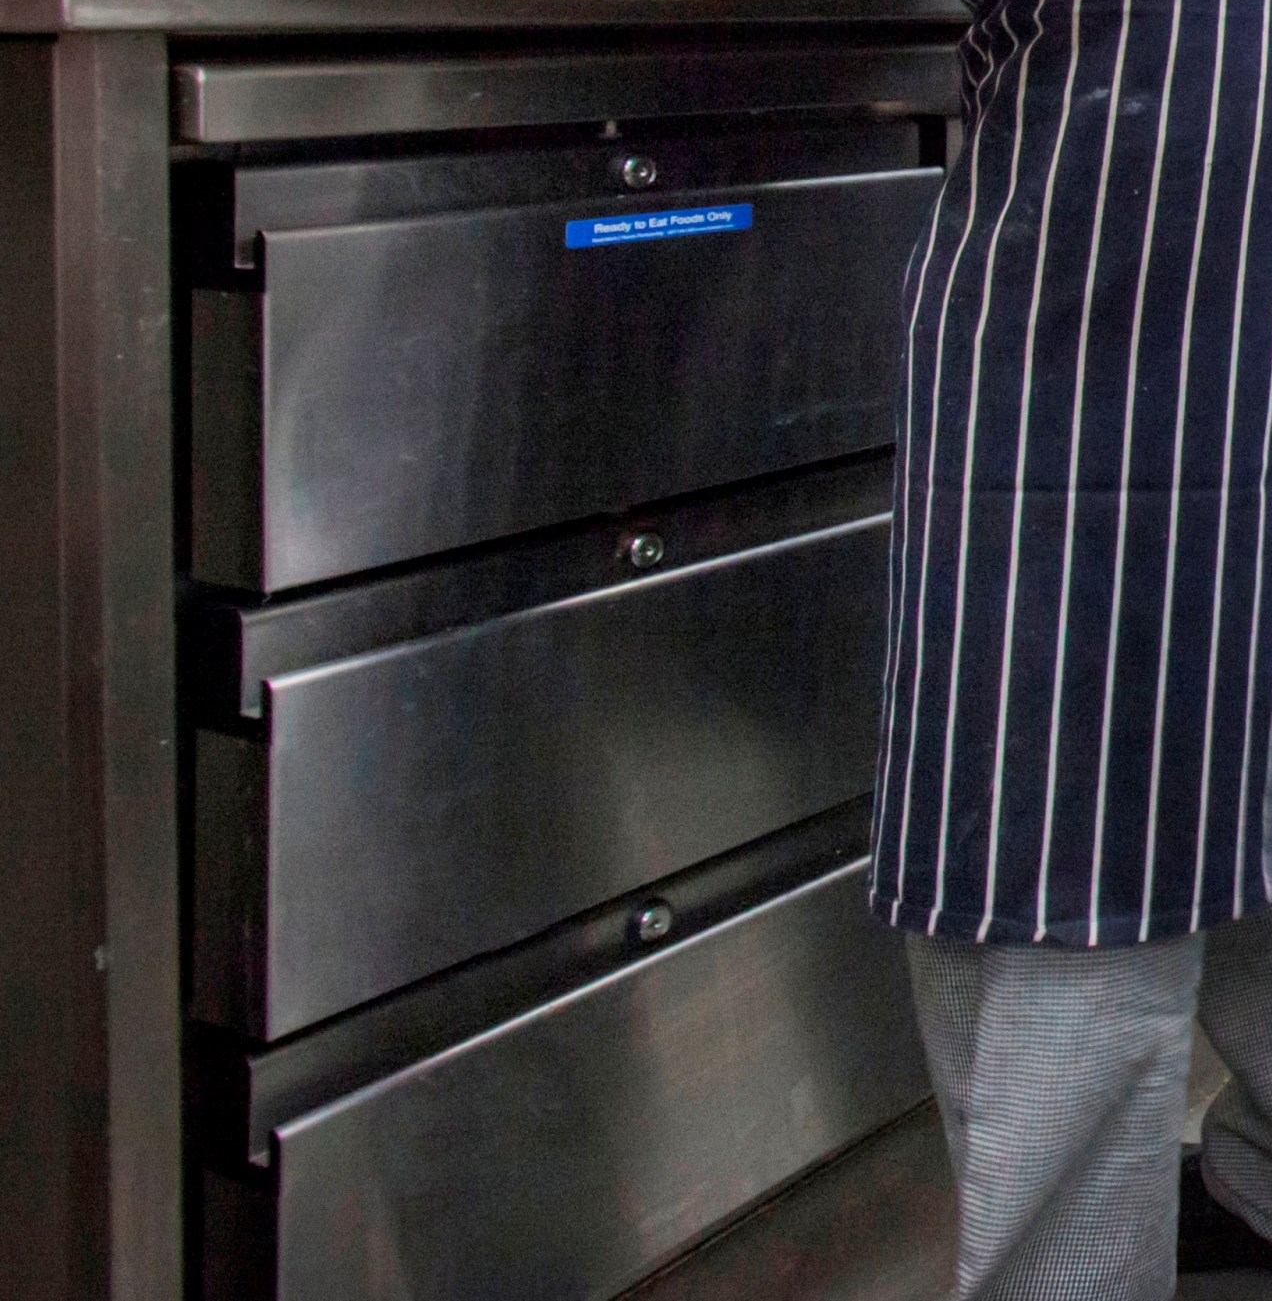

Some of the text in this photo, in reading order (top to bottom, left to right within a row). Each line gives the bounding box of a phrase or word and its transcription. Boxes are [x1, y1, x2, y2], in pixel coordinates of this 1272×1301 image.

[593, 222, 632, 235] Ready
[634, 220, 647, 230] to
[648, 217, 668, 228] Eat
[670, 213, 705, 225] Foods
[707, 211, 732, 222] Only
